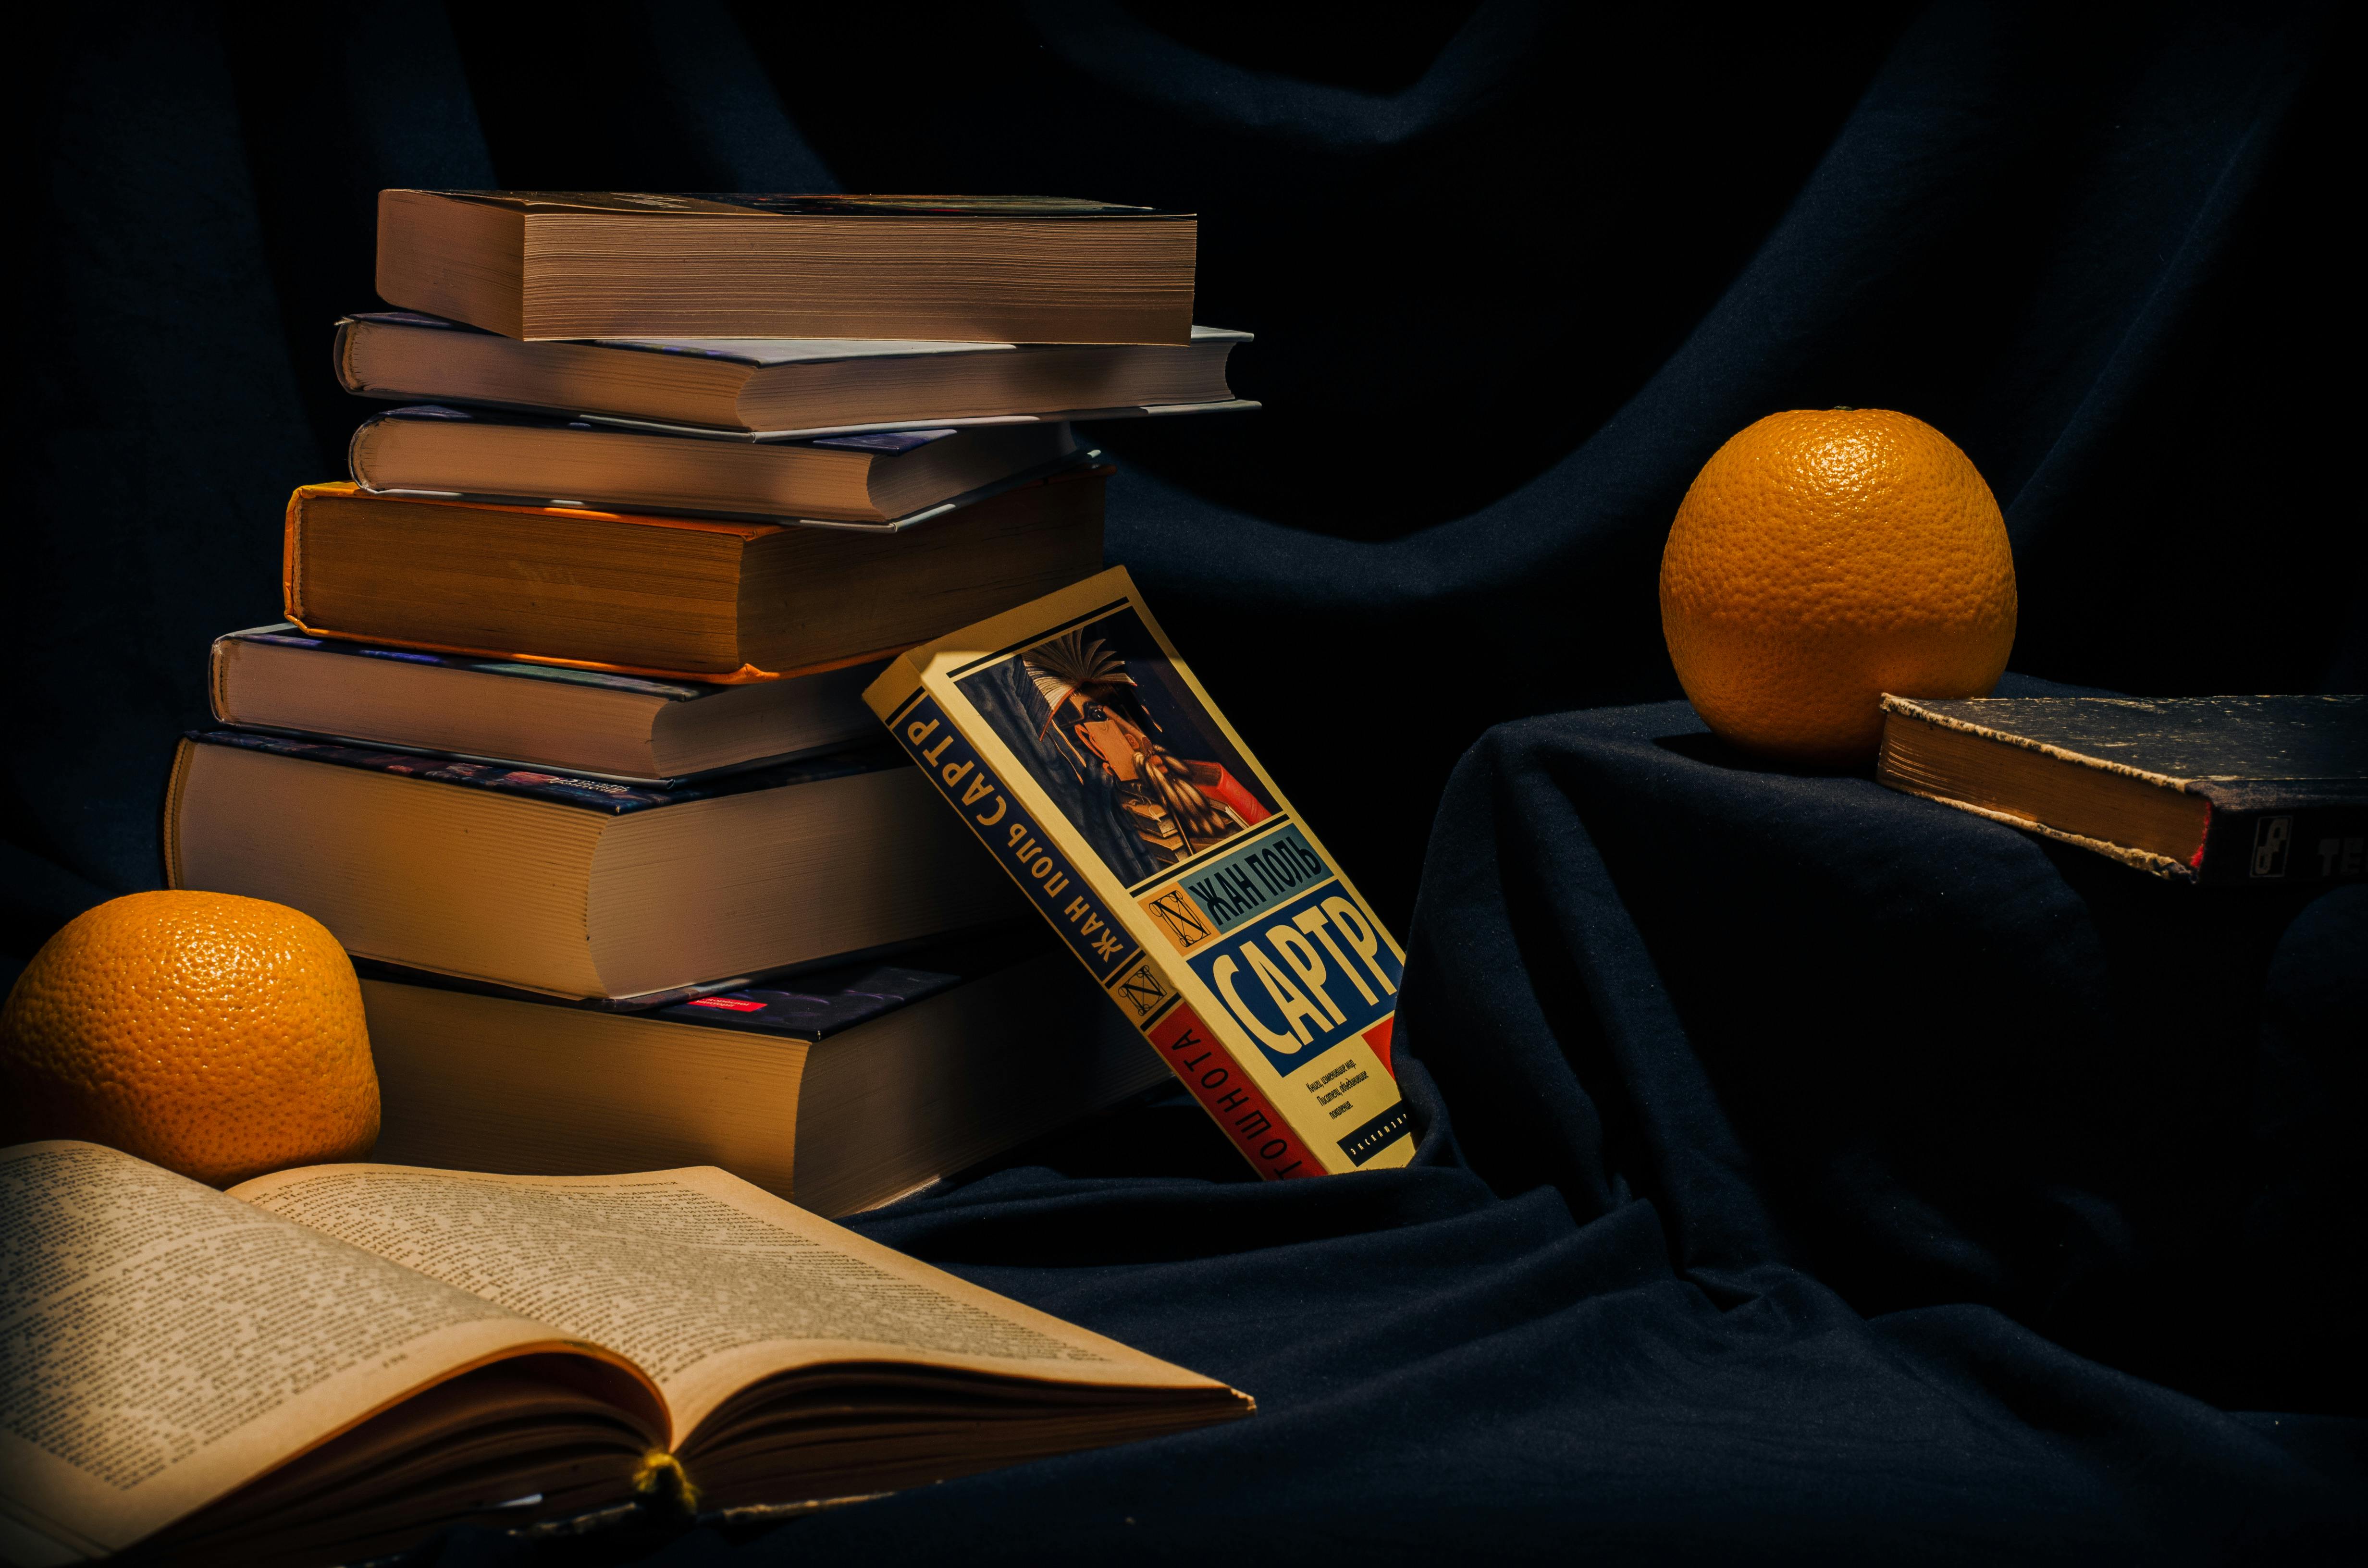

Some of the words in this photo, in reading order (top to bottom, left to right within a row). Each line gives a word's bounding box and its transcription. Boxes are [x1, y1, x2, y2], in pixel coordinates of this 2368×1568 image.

[907, 719, 1007, 826] САРТР
[1007, 823, 1070, 898] ПОЛЬ
[1188, 863, 1267, 926] ЖАН
[1244, 836, 1322, 896] ПОЛЬ
[2317, 837, 2368, 877] ТЕ
[1063, 895, 1124, 962] ЖАН
[1213, 895, 1398, 1054] САРТР
[1306, 1079, 1324, 1093] Книги,
[1320, 1064, 1347, 1085] изменившие
[1344, 1059, 1357, 1070] мир.
[1317, 1088, 1343, 1107] Писатели,
[1339, 1070, 1369, 1093] объединившие
[1172, 1028, 1303, 1181] ТОШНОТА
[1329, 1100, 1354, 1120] поколения.
[278, 1174, 356, 1190] гроссбухов
[303, 1190, 354, 1207] должен
